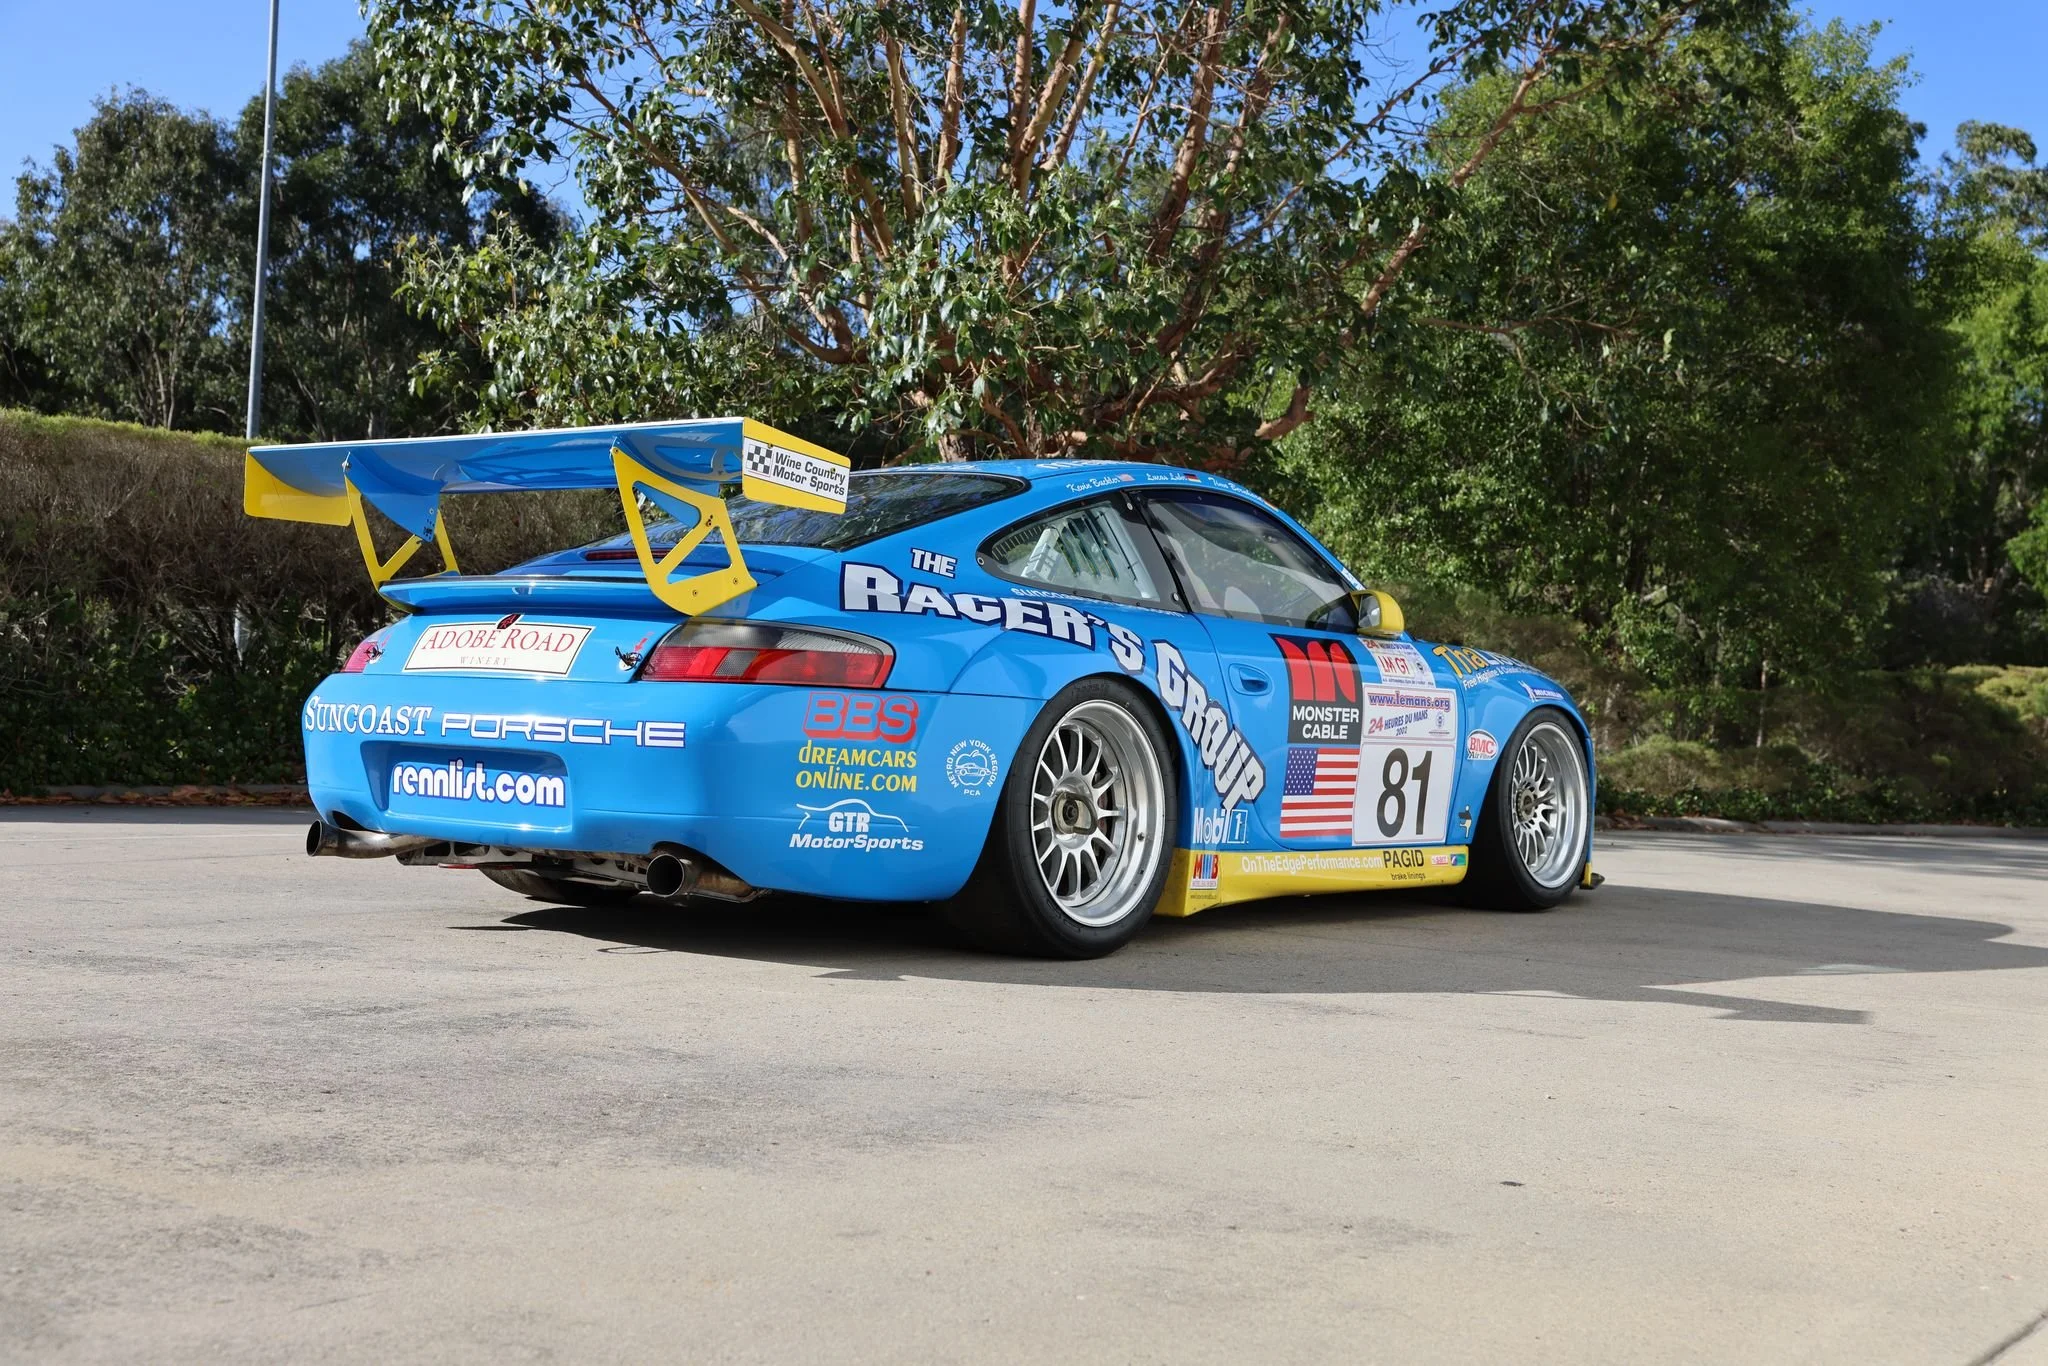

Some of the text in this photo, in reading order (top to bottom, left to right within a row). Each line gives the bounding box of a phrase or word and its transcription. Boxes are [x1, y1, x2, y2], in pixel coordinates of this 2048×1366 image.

[775, 451, 846, 485] Wine Country
[773, 466, 845, 496] Motor Sports
[911, 547, 958, 579] THE
[421, 627, 575, 653] ADOBE ROAD
[460, 656, 511, 665] WINERY
[840, 561, 1267, 812] RACER'S GROUP
[1462, 678, 1477, 691] Free
[1368, 690, 1451, 712] www.lemans.org
[305, 695, 687, 748] SUNCOAST PORSCHE
[802, 691, 920, 743] BBS
[1292, 705, 1360, 723] MONSTER
[1368, 709, 1429, 734] 24 HEURES DU MANS
[1302, 724, 1348, 740] CABLE
[1470, 737, 1494, 754] BMC
[946, 739, 998, 788] METRO NEW YORK REGION
[392, 758, 566, 808] rennlist.com
[964, 788, 980, 796] PCA
[1376, 747, 1433, 838] 81
[829, 812, 870, 833] GTR
[1192, 807, 1230, 845] Mobil
[789, 833, 924, 852] MotorSports
[1242, 854, 1383, 875] OnTheEdgePerformance.com
[1383, 849, 1425, 868] PAGID
[1391, 871, 1426, 881] brake linings
